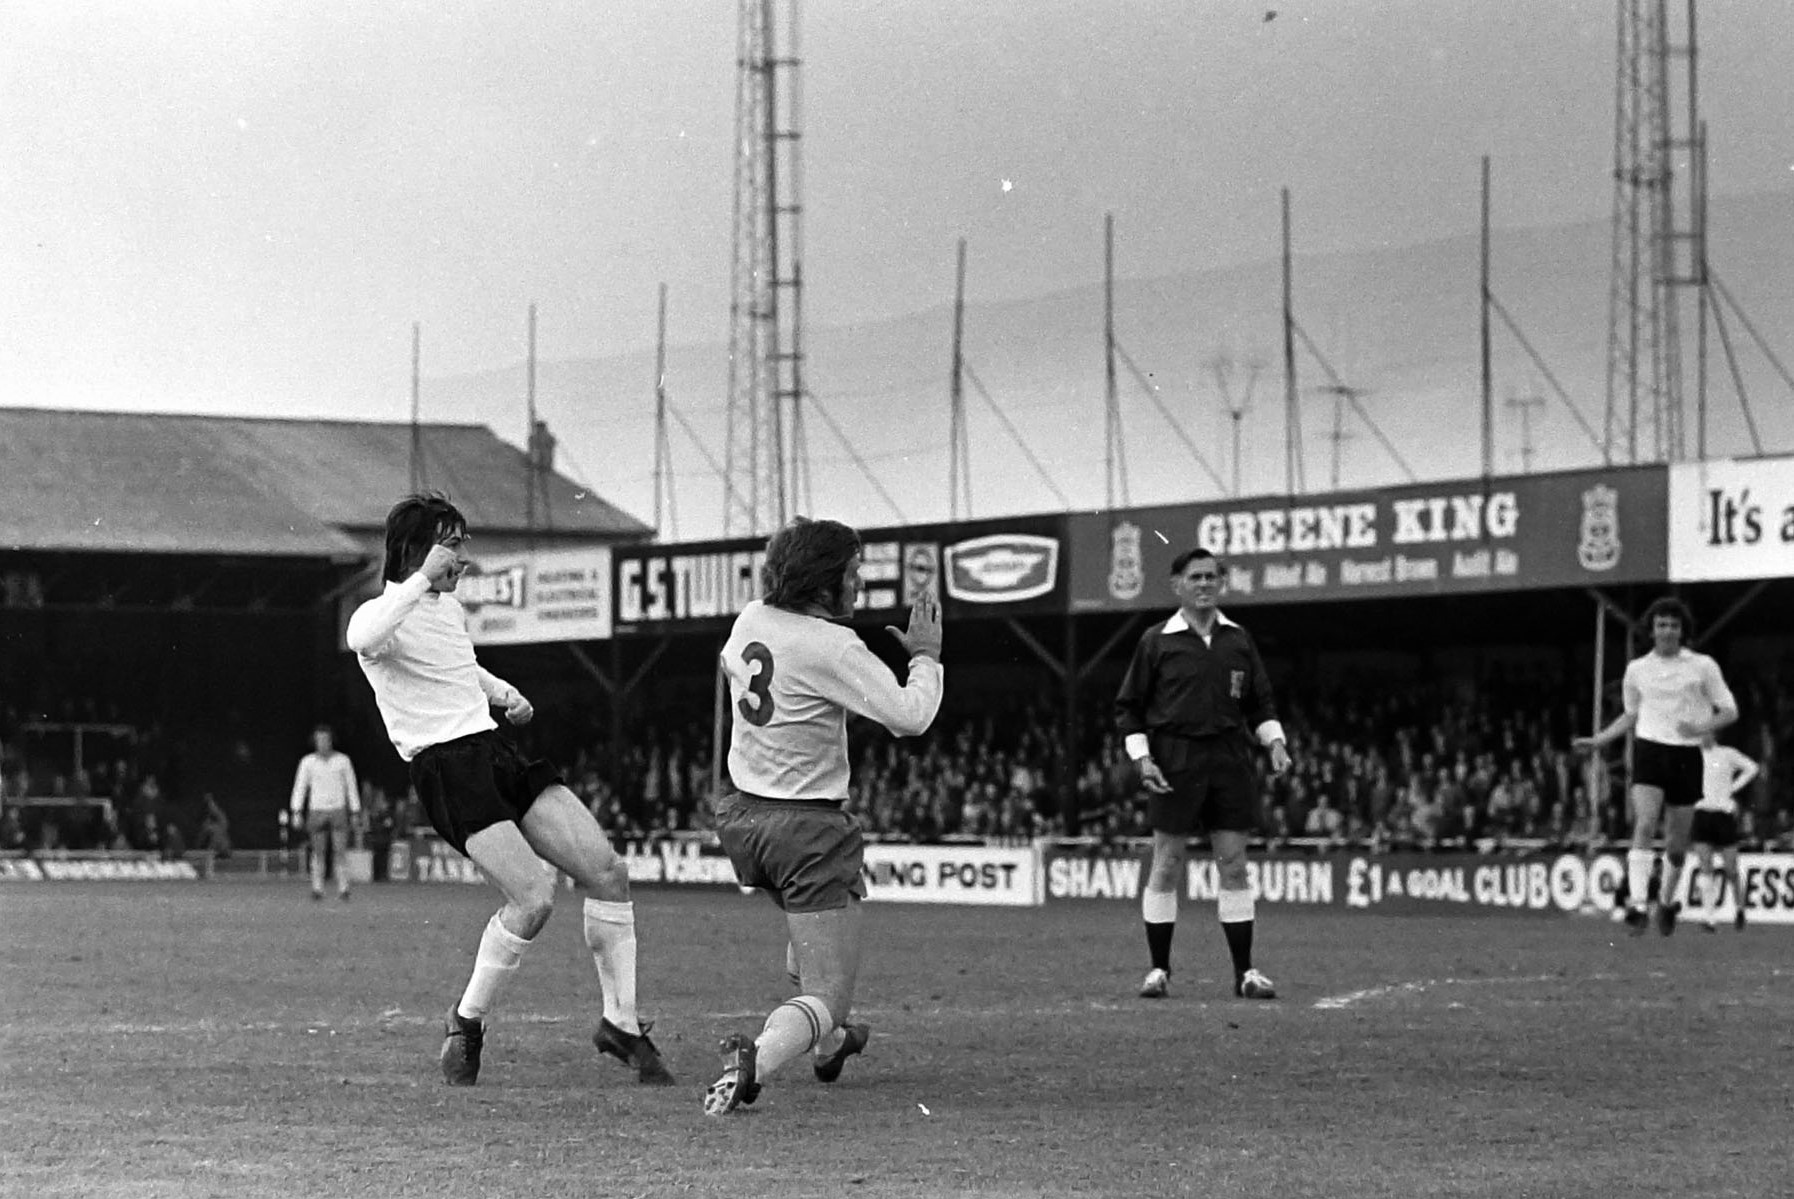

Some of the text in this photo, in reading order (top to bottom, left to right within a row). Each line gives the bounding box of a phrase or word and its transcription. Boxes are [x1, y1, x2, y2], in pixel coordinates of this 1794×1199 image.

[1197, 491, 1519, 556] GREENE KING
[1707, 488, 1761, 545] It's
[738, 641, 775, 727] 3
[939, 861, 1018, 889] POST
[1049, 857, 1333, 902] SHAW KIBURN
[1346, 857, 1383, 908] £1
[1406, 866, 1470, 902] GOAL
[1473, 862, 1550, 909] CLUB
